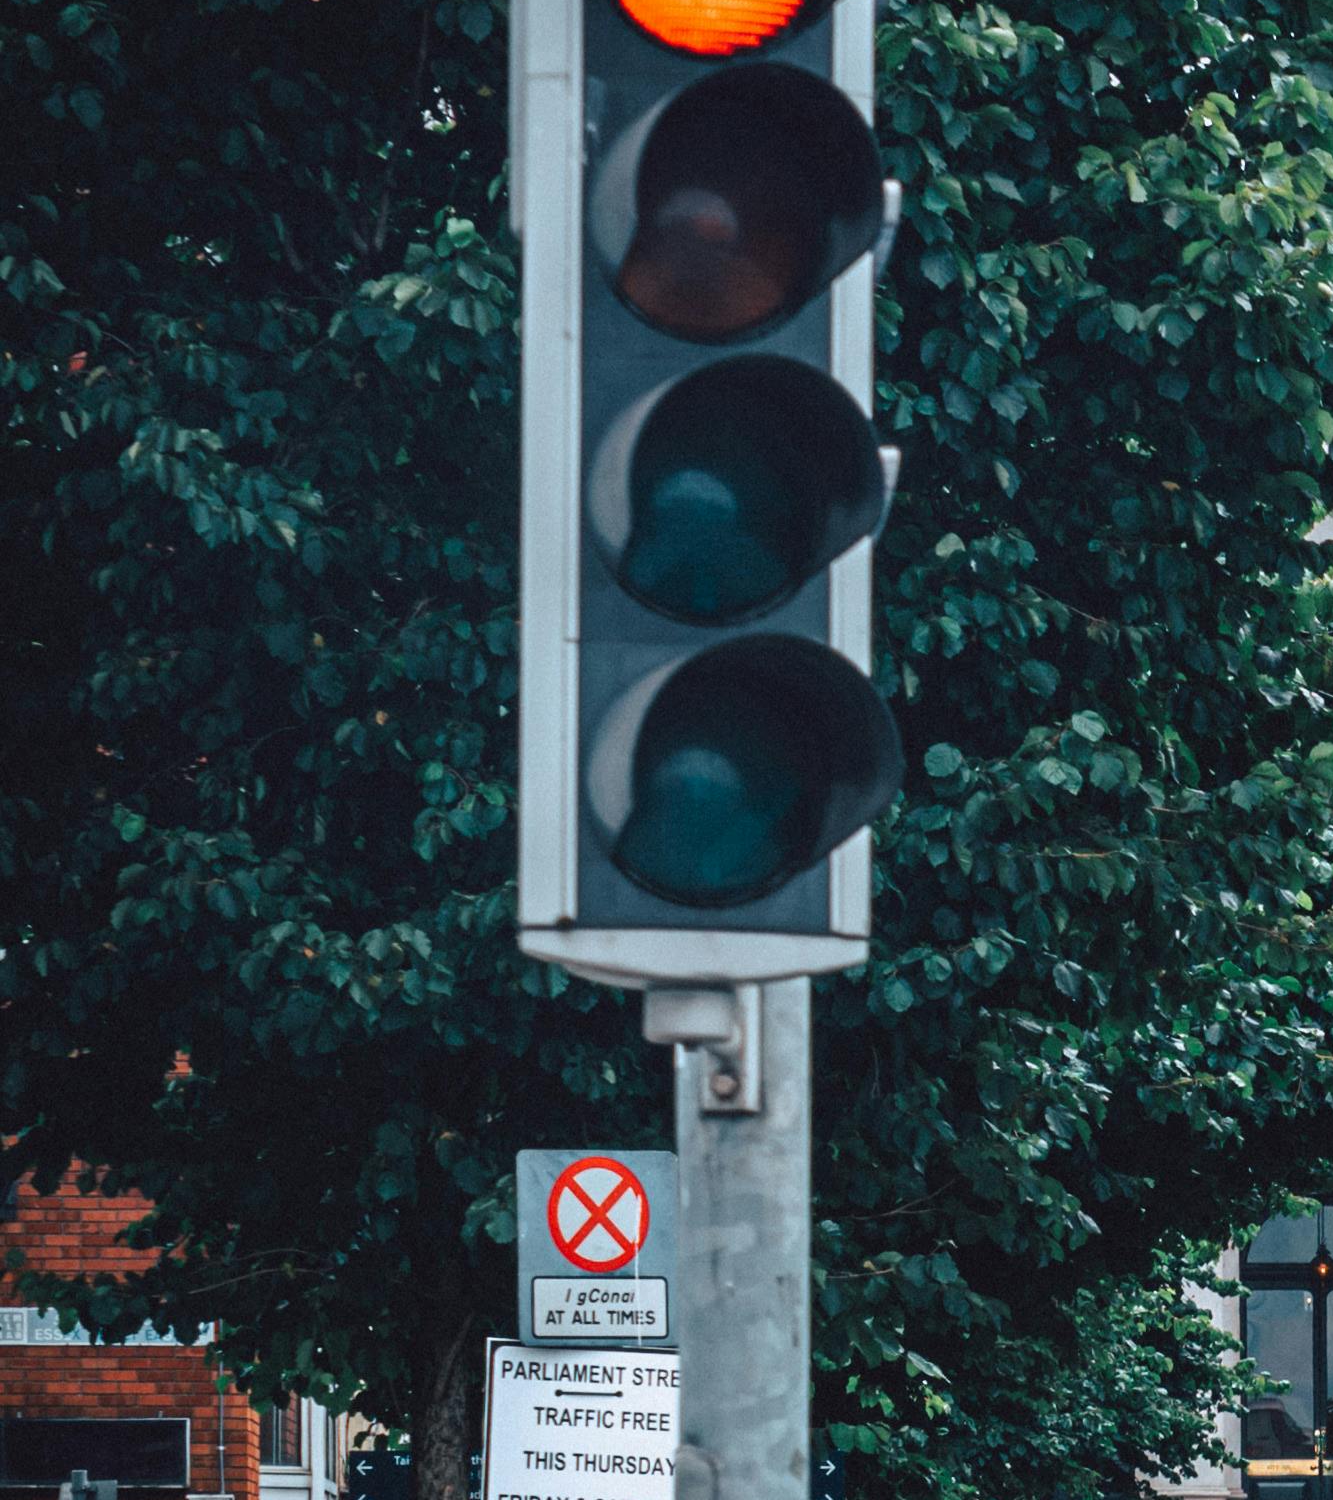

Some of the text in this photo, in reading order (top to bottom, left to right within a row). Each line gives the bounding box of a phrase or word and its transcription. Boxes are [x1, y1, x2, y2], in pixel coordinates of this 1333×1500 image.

[546, 1310, 656, 1325] AT ALL TIMES
[501, 1361, 680, 1388] PARLIAMENT STRE
[534, 1406, 670, 1431] TRAFFIC FREE
[523, 1450, 676, 1476] THIS THURSDAY
